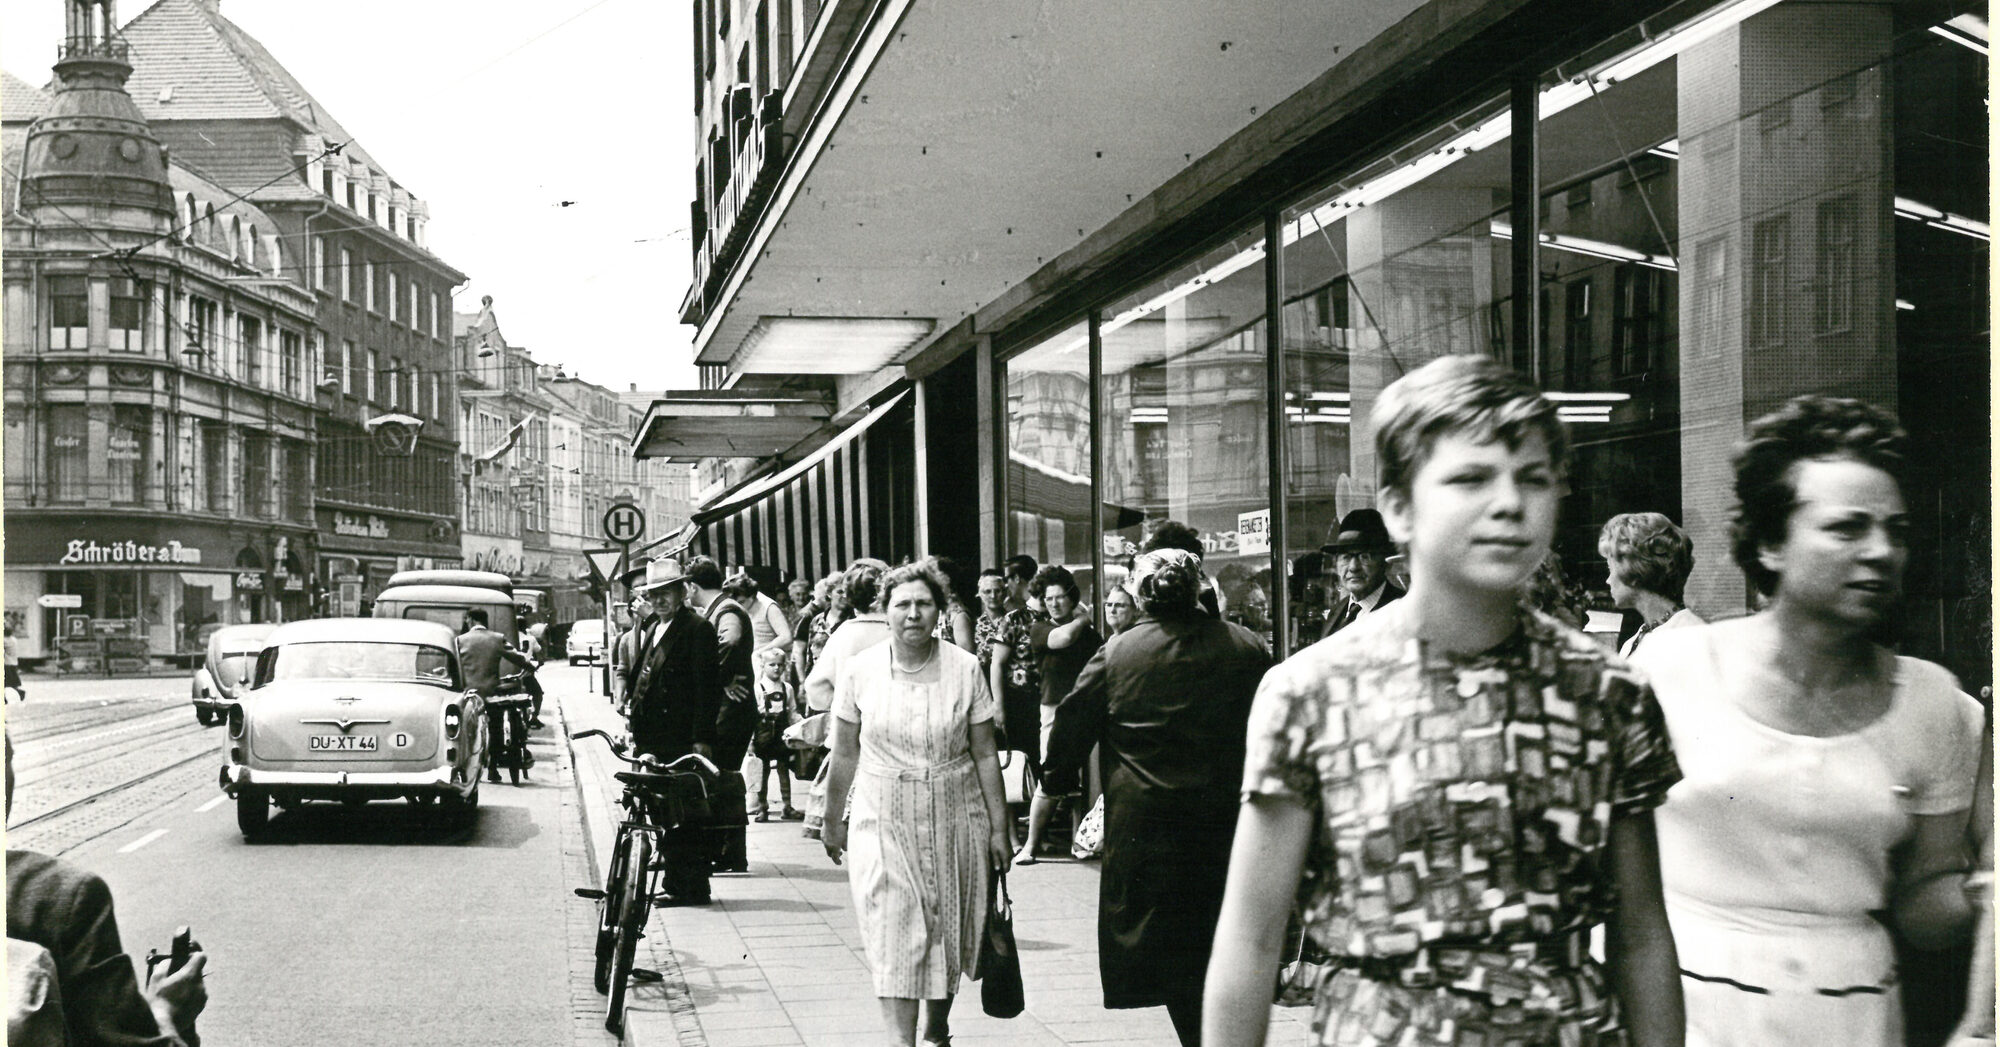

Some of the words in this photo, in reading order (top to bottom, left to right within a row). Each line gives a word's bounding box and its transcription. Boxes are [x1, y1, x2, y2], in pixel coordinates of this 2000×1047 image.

[614, 512, 635, 536] H
[60, 539, 156, 565] Schröder
[311, 736, 356, 749] DU-XT
[359, 736, 375, 749] 44
[396, 733, 407, 747] D
